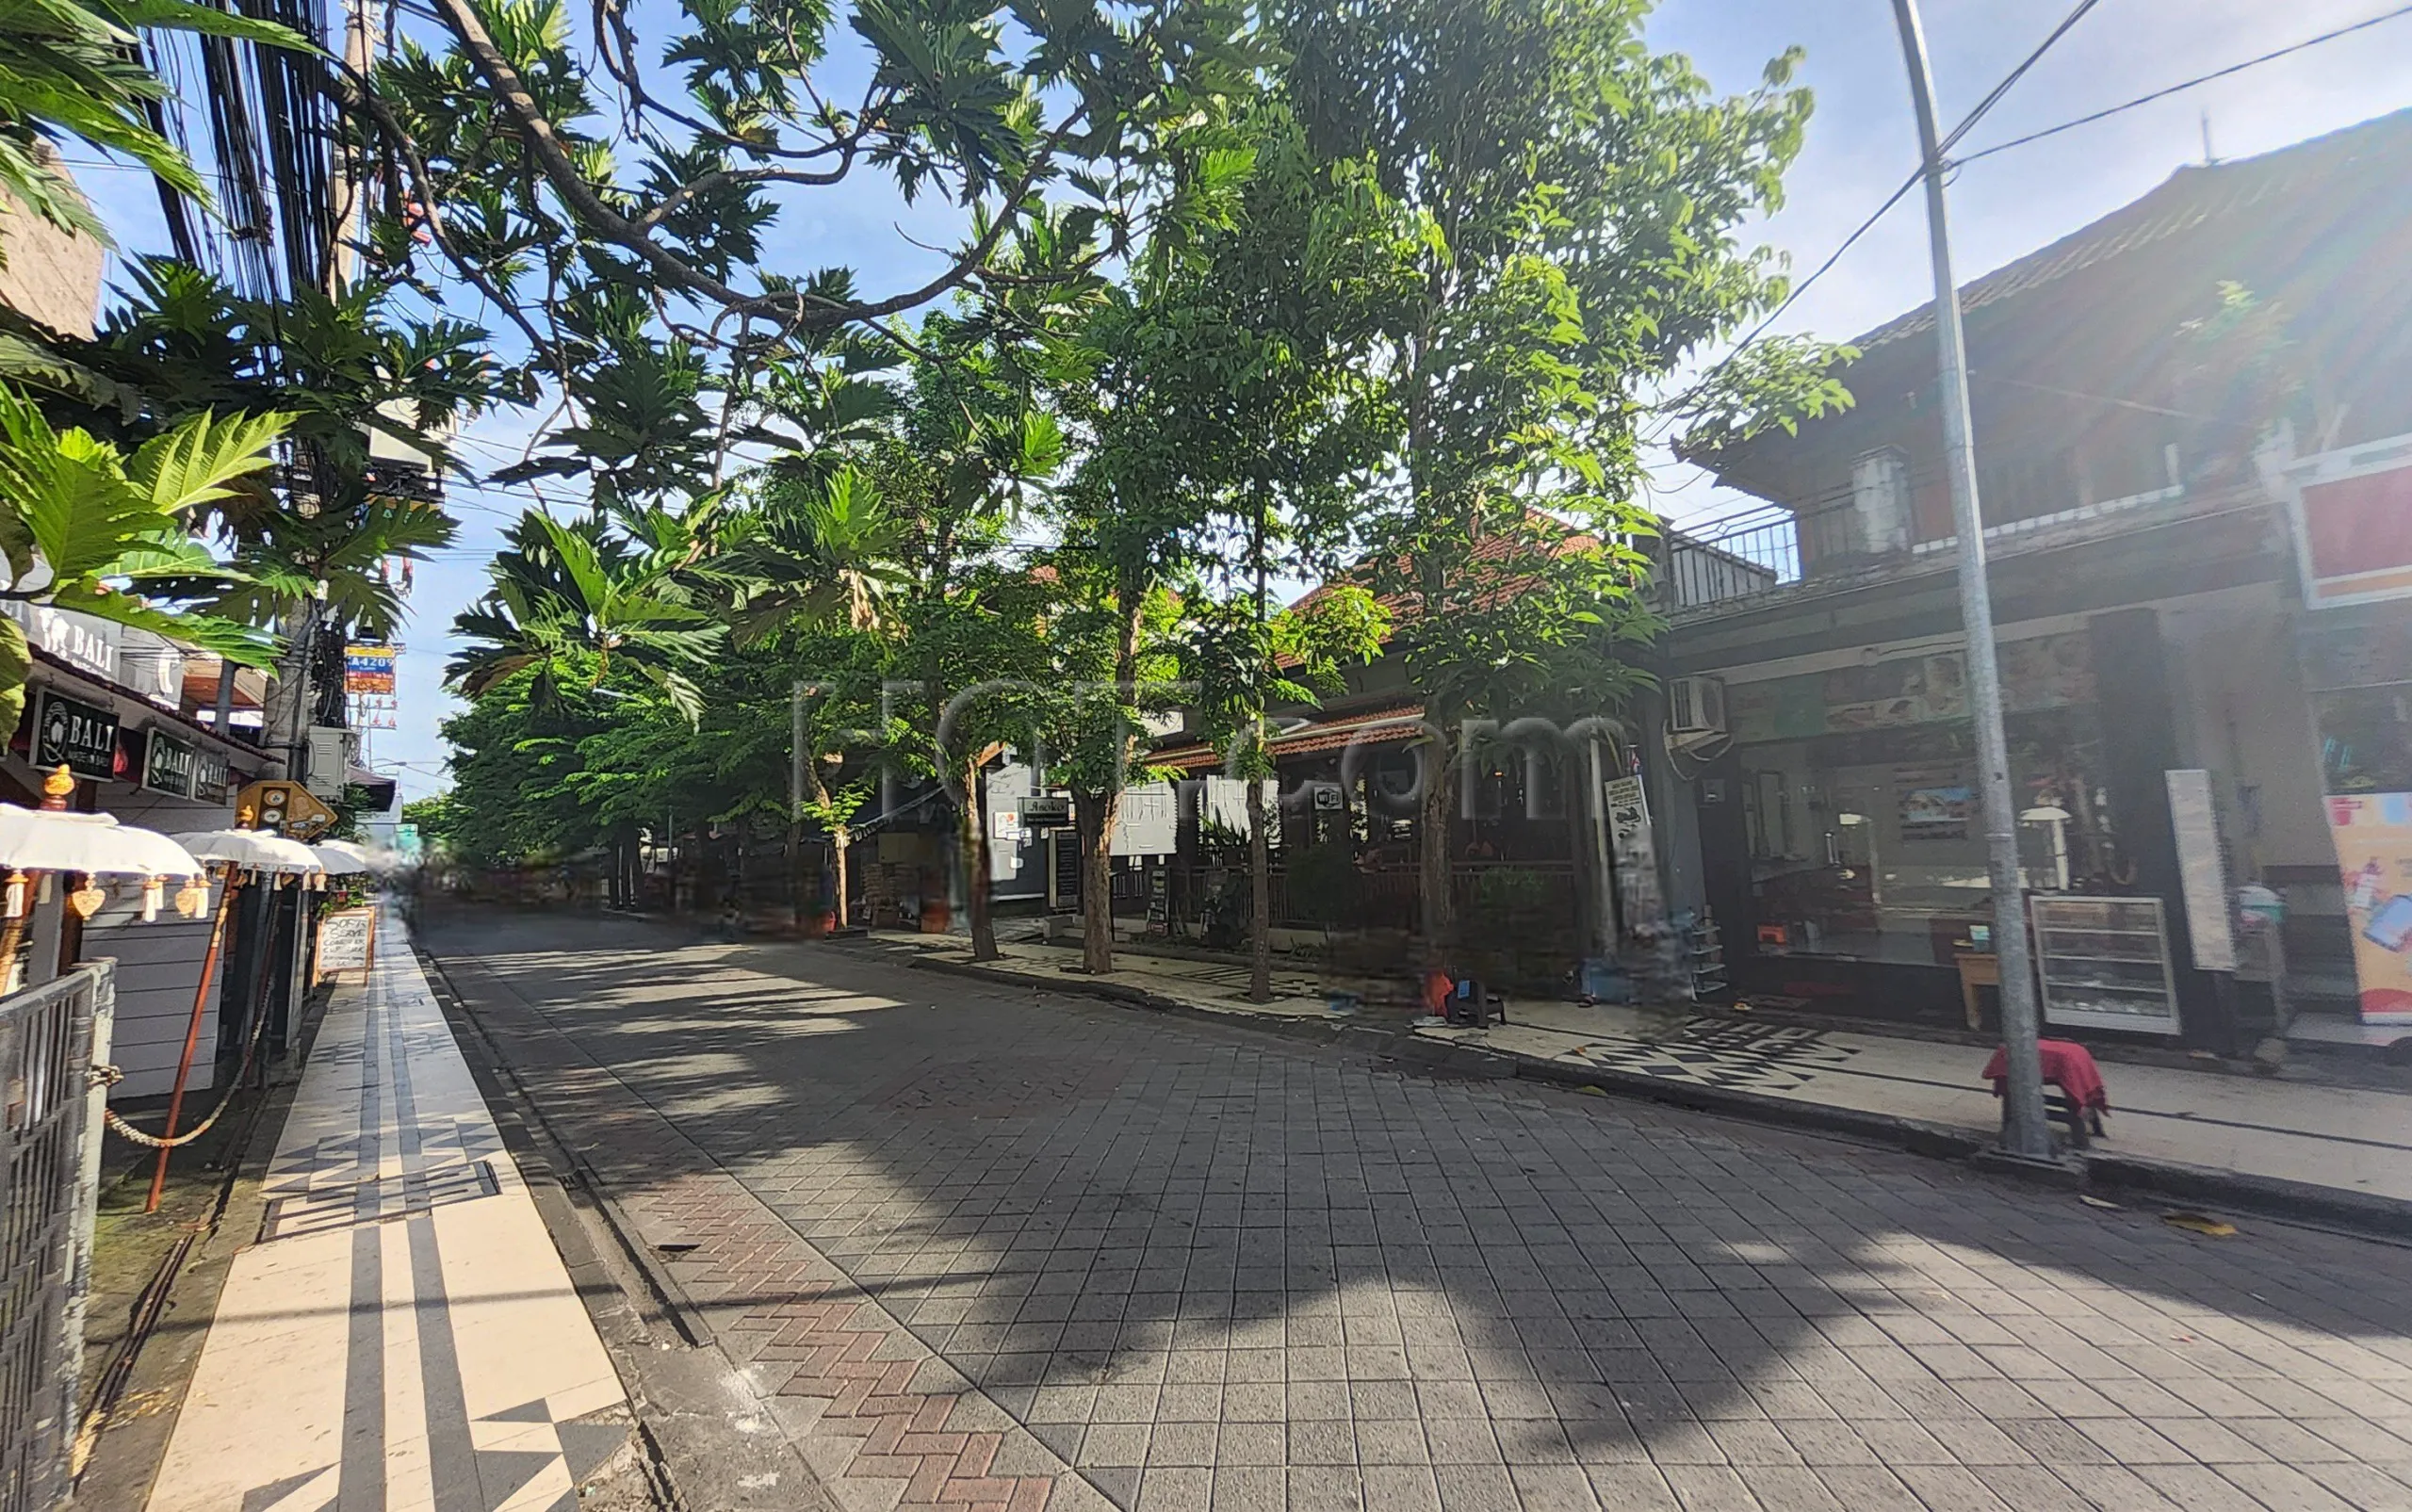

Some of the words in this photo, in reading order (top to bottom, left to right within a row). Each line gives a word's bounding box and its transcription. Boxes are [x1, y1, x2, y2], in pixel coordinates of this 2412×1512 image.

[73, 626, 113, 673] BALI
[69, 715, 114, 753] BALI
[164, 747, 190, 776] BALI
